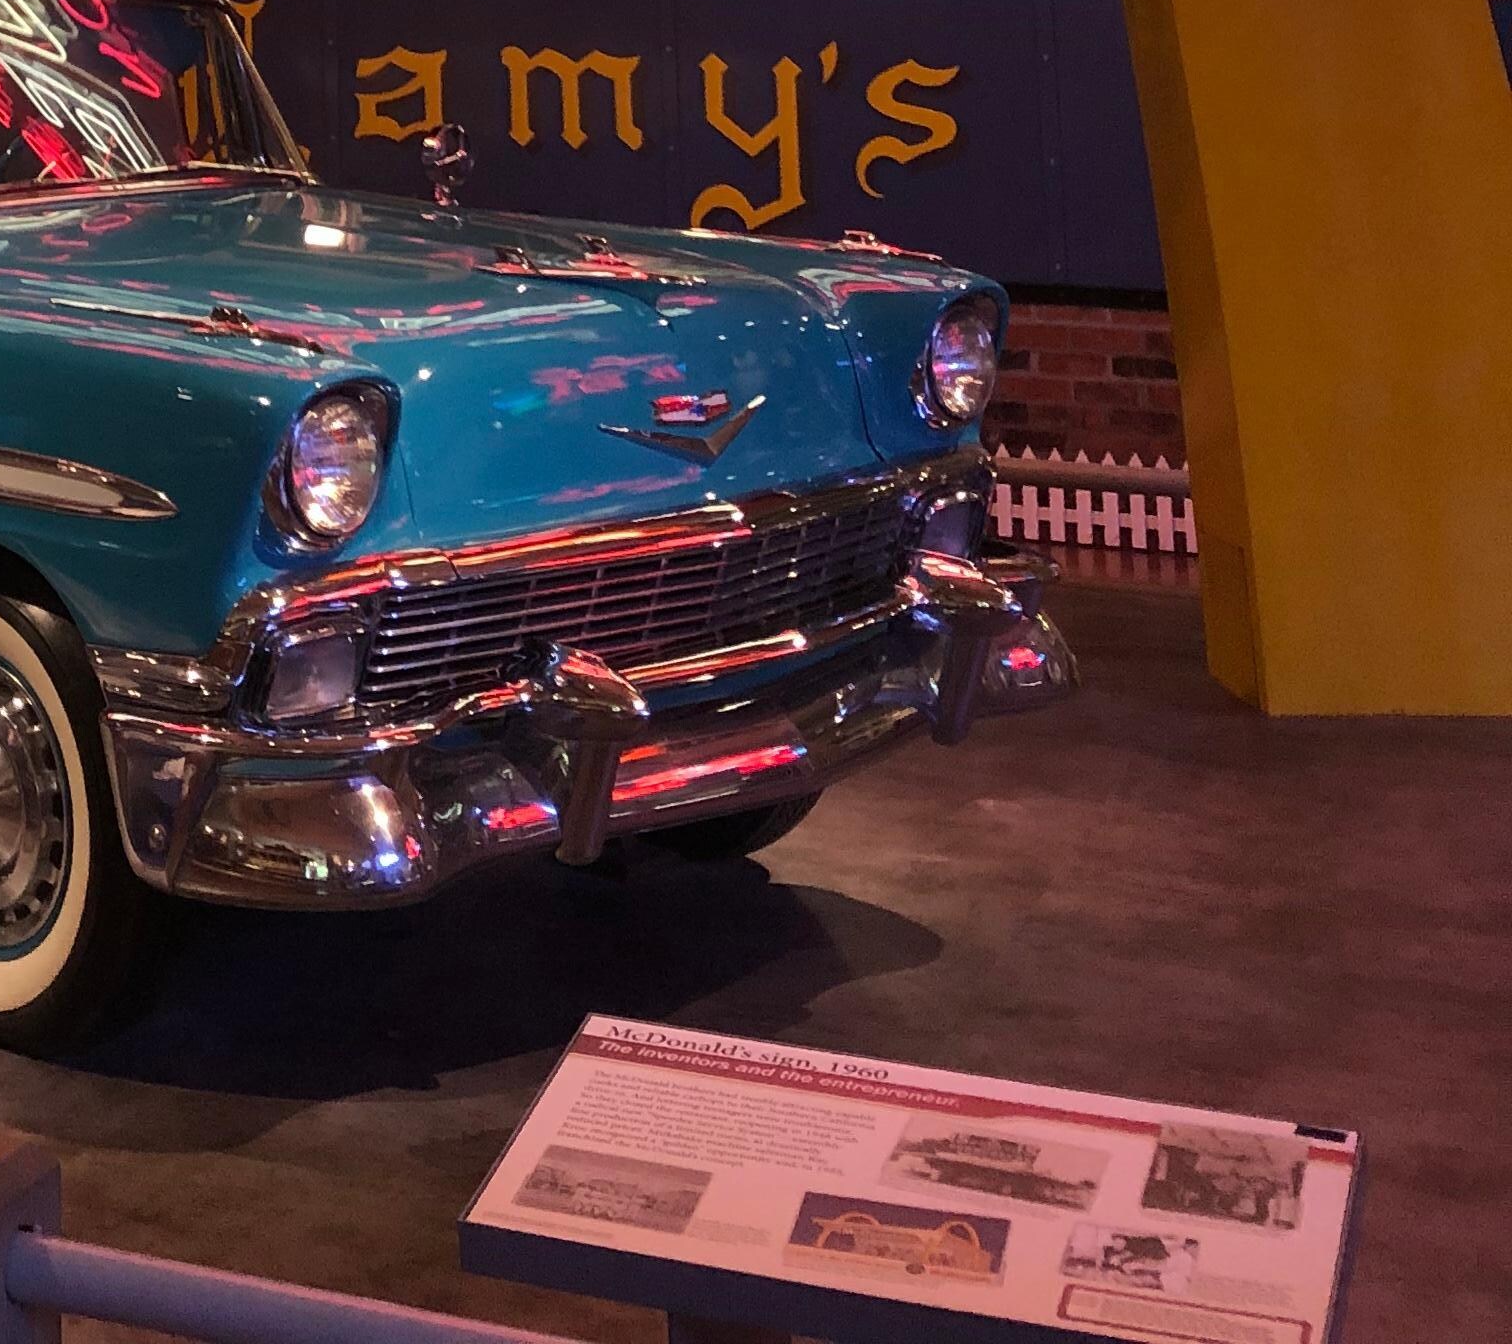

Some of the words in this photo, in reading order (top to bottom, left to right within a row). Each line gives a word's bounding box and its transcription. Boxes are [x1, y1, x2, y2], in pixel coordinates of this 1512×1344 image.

[598, 1040, 633, 1055] The
[637, 1046, 730, 1071] inventors
[734, 1063, 776, 1078] and
[779, 1068, 814, 1084] the
[605, 1024, 752, 1058] McDonald's
[758, 1051, 818, 1073] sign,
[829, 1062, 890, 1080] 1960
